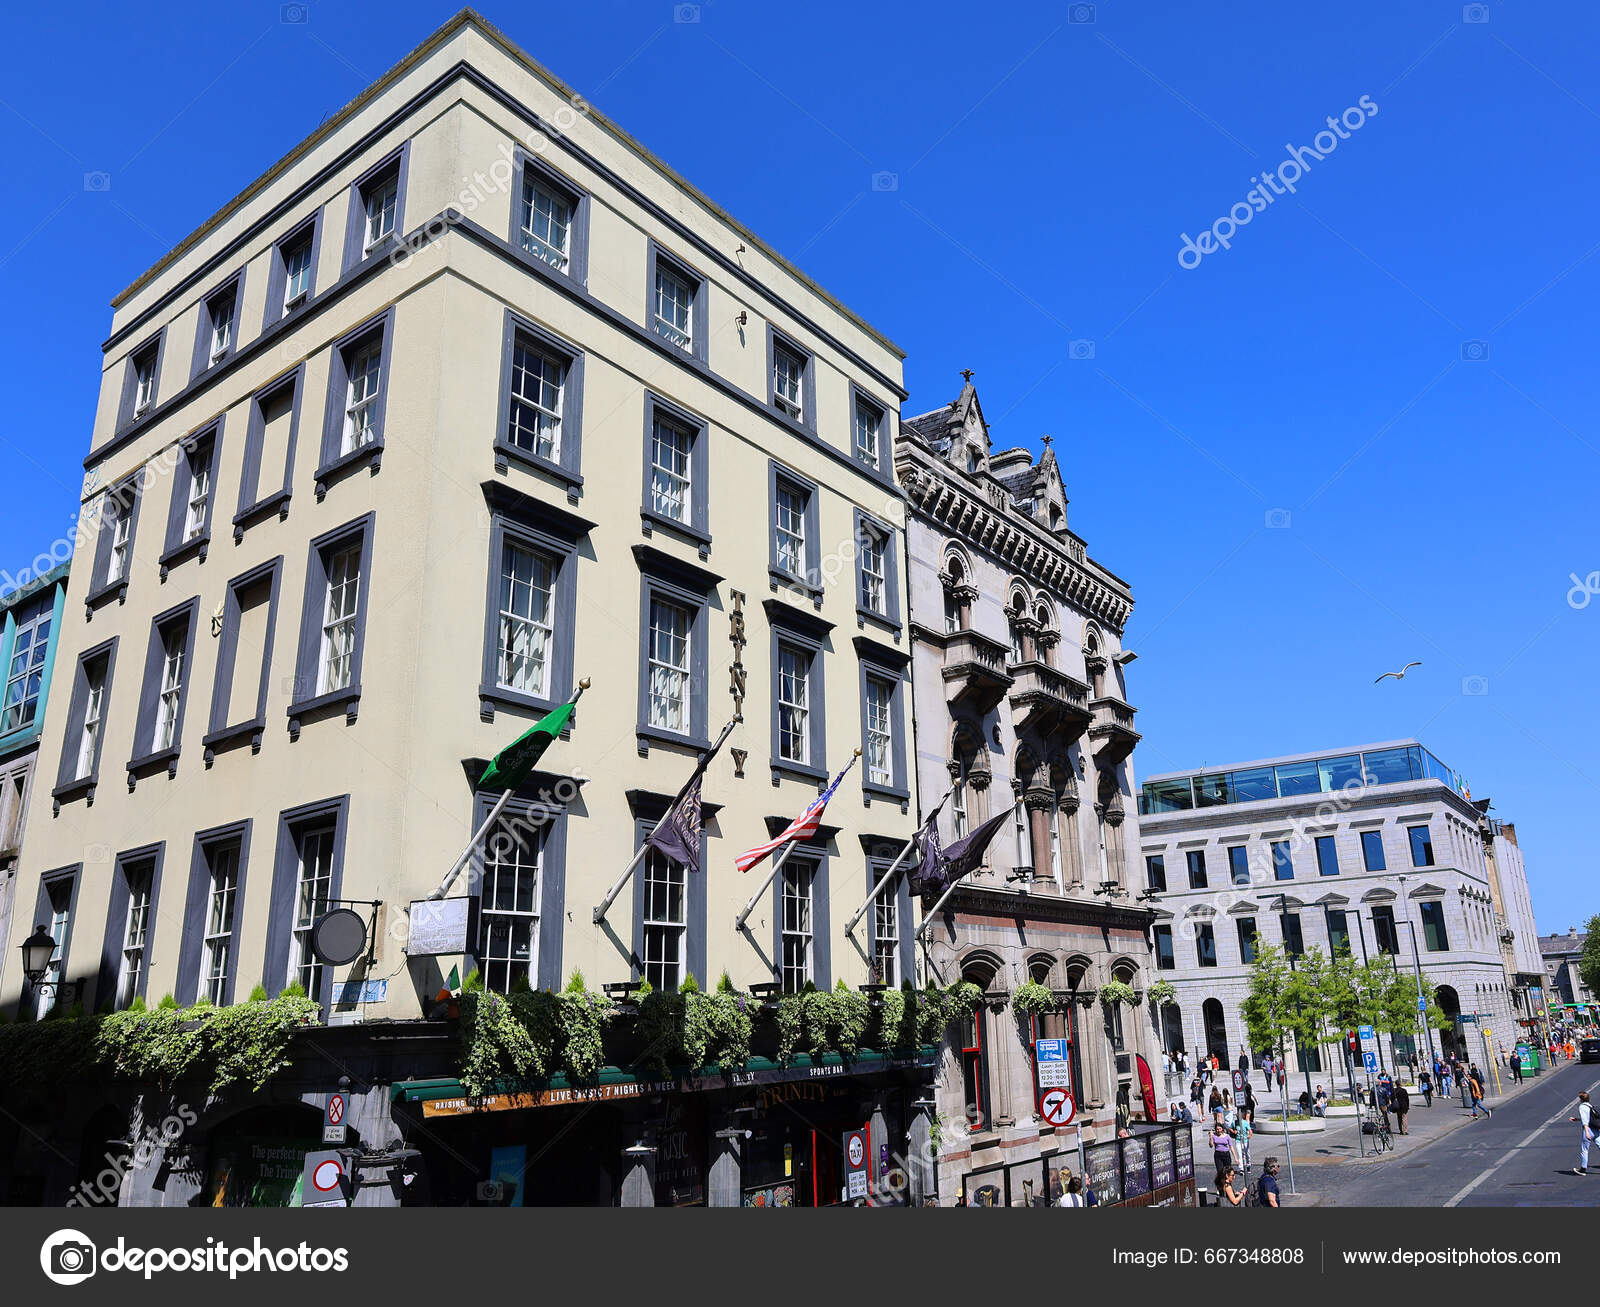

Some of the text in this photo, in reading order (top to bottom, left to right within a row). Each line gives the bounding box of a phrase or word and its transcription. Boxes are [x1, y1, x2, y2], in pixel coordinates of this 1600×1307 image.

[810, 1067, 831, 1077] SPORTS
[833, 1065, 843, 1075] BAR
[435, 1099, 465, 1110] RAISING
[550, 1090, 571, 1102] LIVE
[605, 1087, 611, 1097] 7
[614, 1084, 645, 1096] NIGHTS
[655, 1081, 676, 1092] WEEK
[850, 1148, 862, 1159] TAXI
